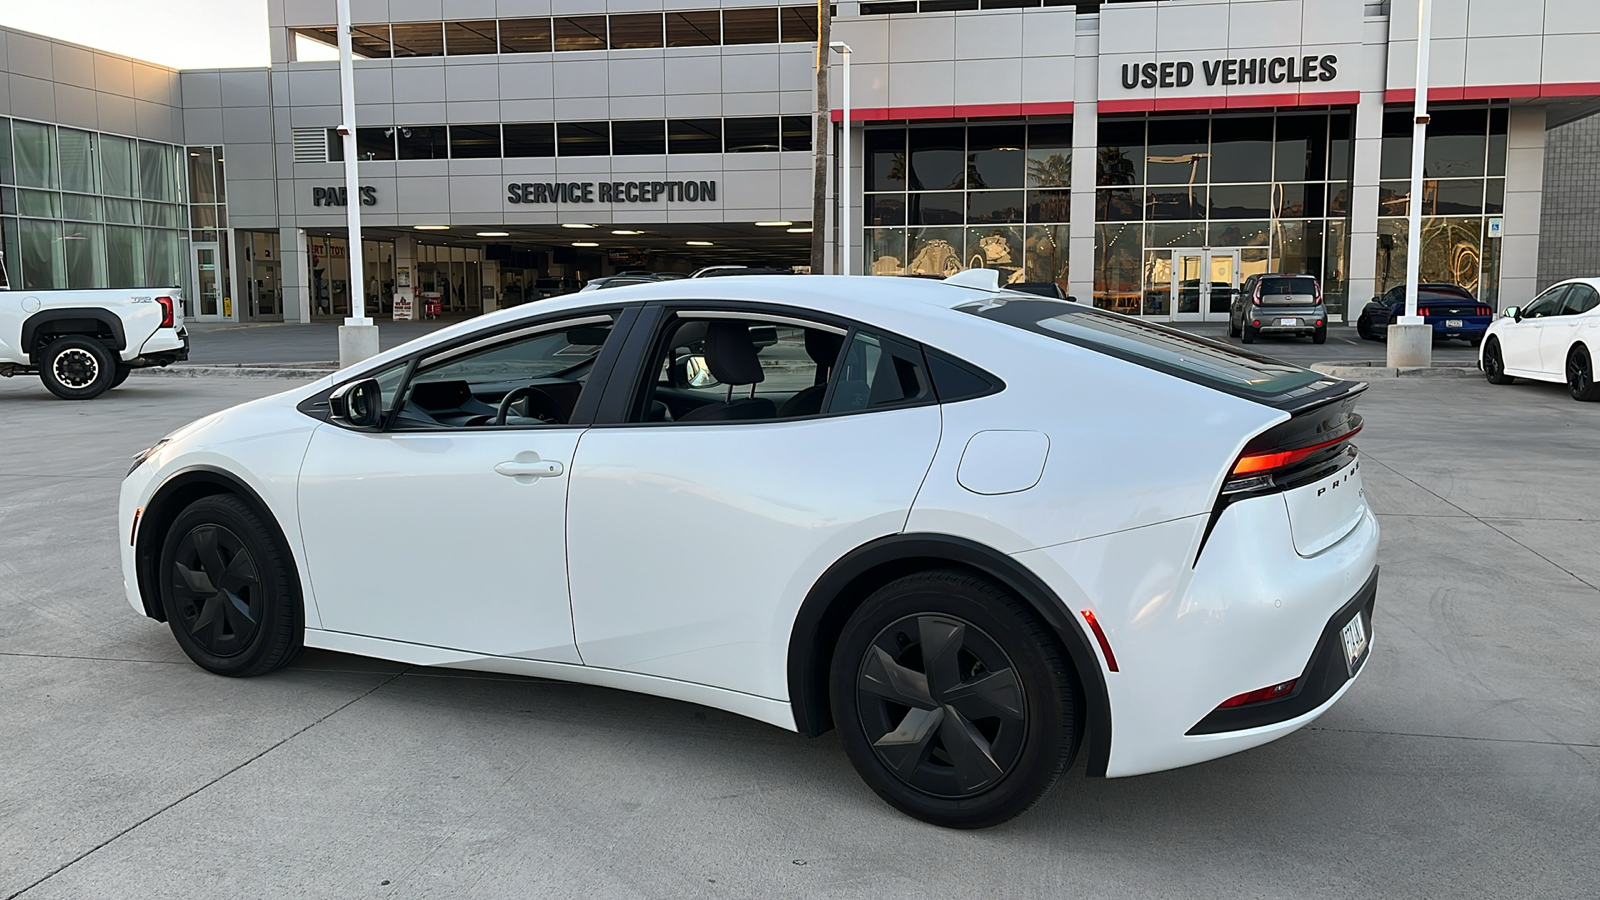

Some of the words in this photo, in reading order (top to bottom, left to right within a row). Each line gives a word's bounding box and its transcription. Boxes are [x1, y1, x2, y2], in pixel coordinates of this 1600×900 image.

[1121, 61, 1194, 90] USED
[1202, 55, 1338, 86] VEHICLES
[507, 182, 594, 204] SERVICE
[598, 181, 716, 204] RECEPTION
[330, 245, 346, 256] TOY
[1317, 461, 1360, 497] PRIUS
